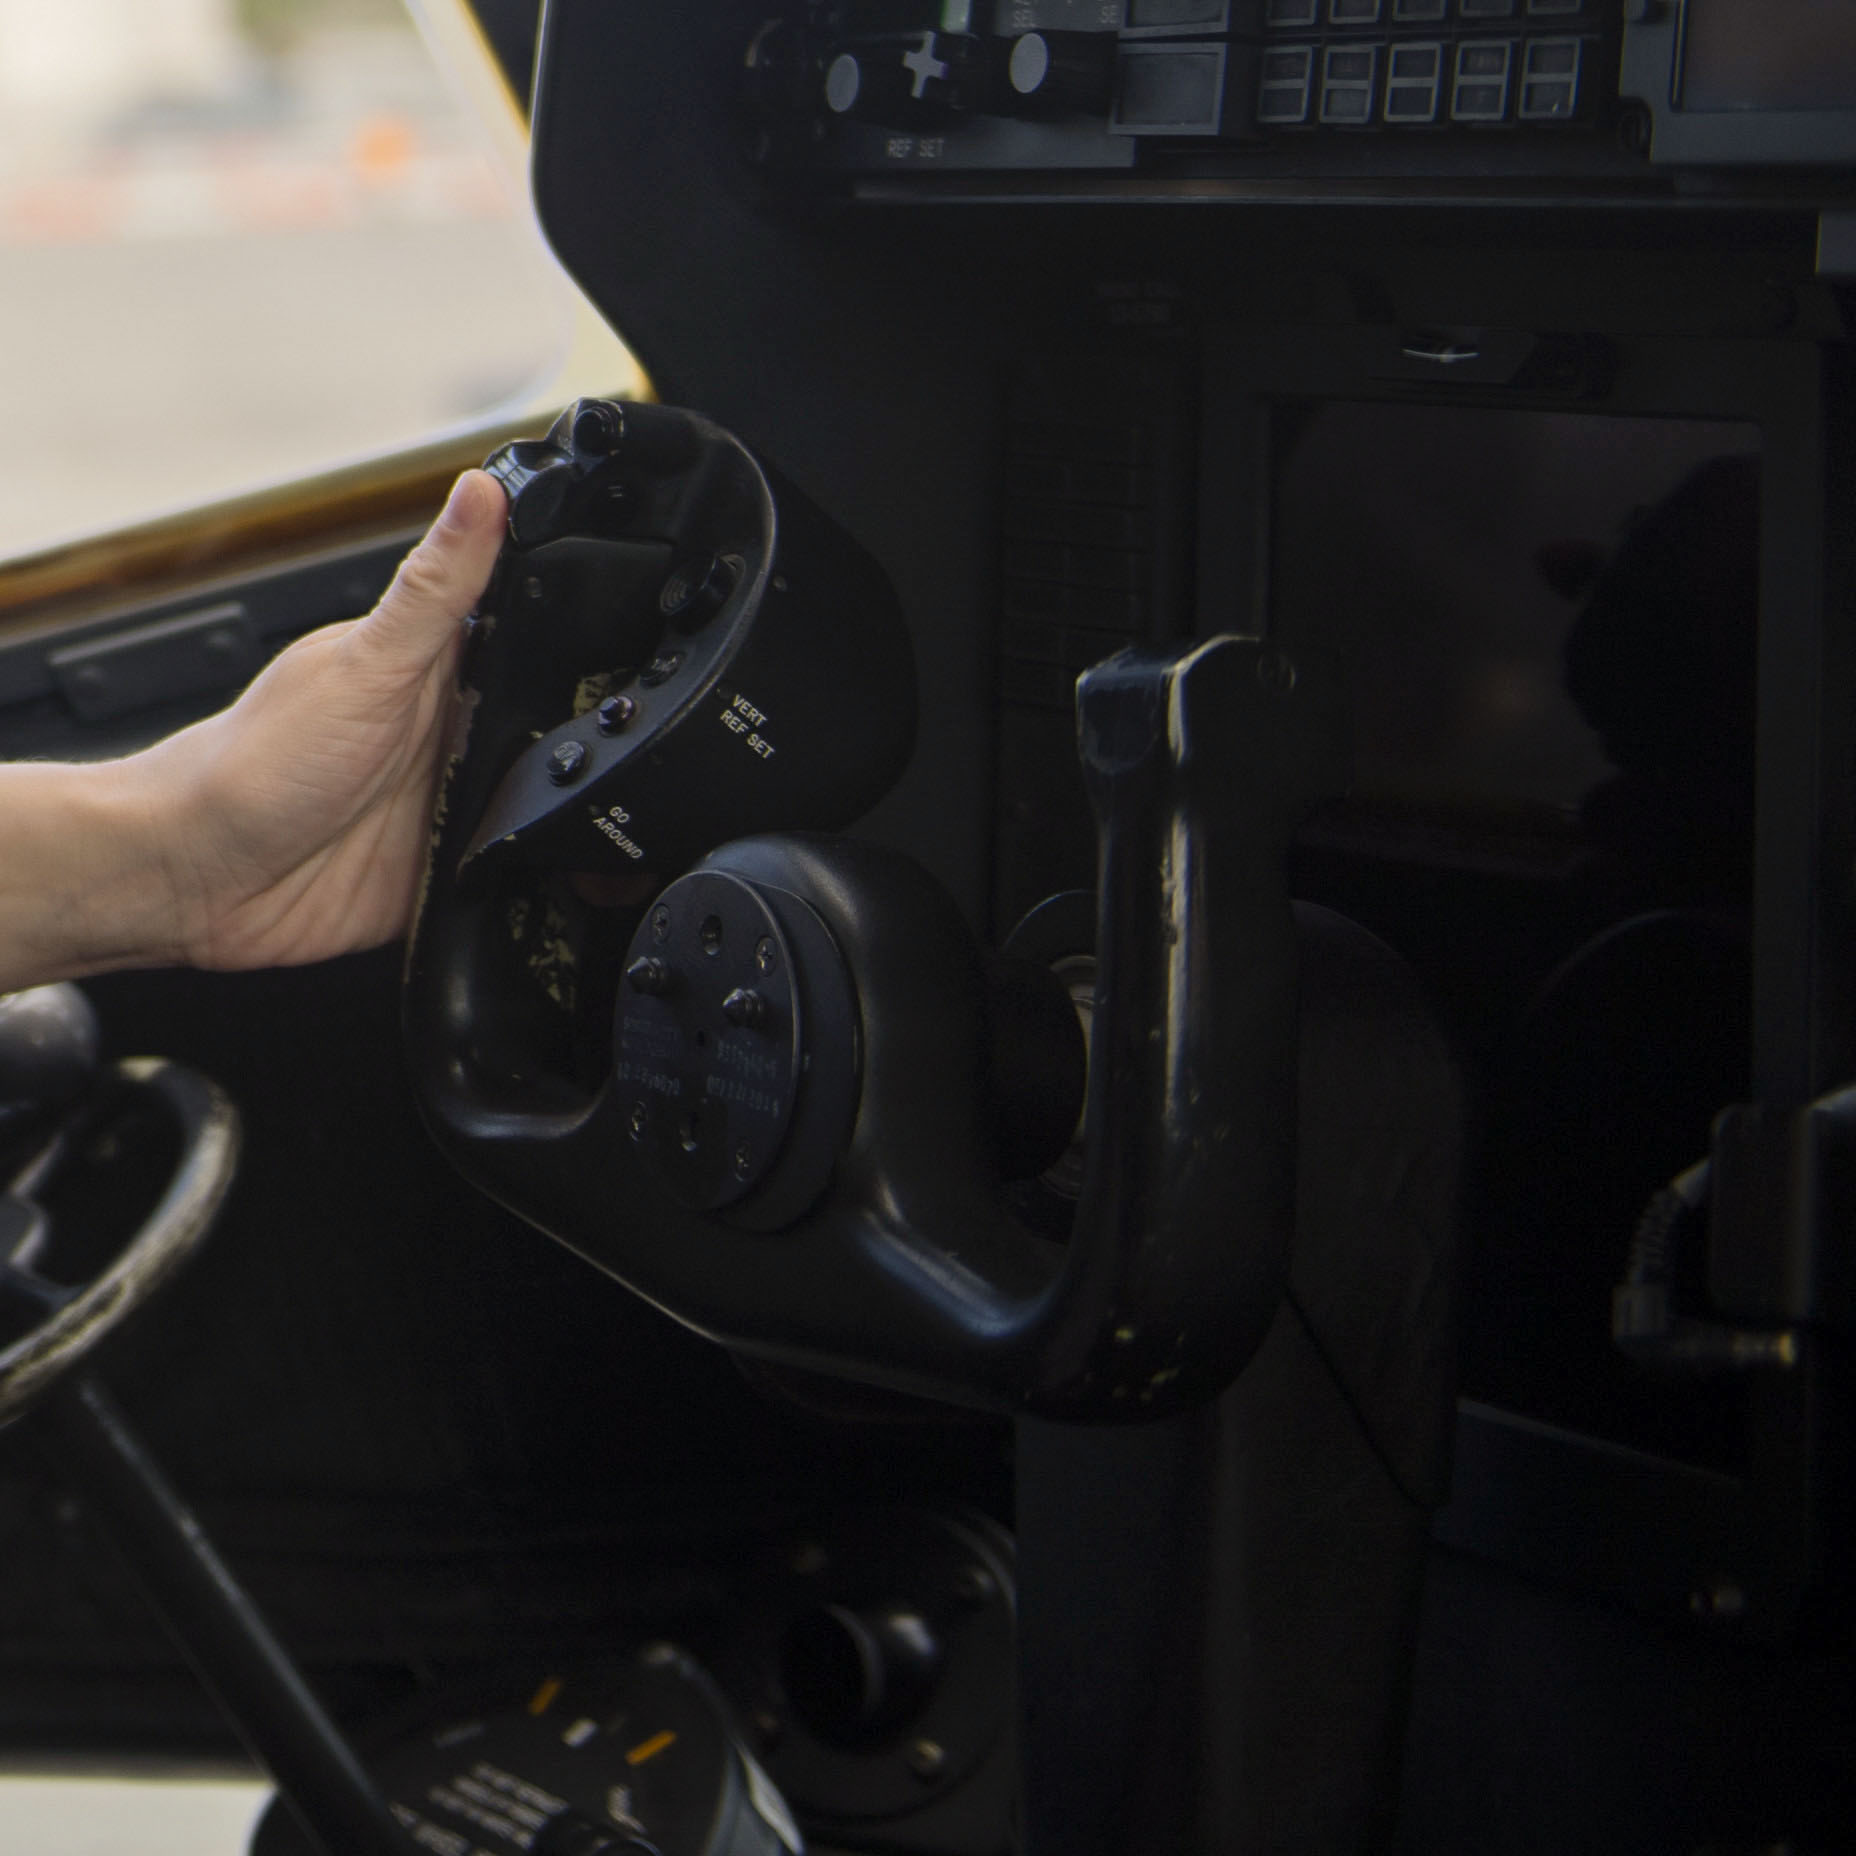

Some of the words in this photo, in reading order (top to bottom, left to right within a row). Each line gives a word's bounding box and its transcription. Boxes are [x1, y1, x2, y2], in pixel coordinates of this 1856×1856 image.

[1012, 8, 1037, 28] SEL
[1100, 5, 1119, 24] SE
[888, 138, 913, 158] REF
[919, 138, 944, 158] SET
[731, 694, 768, 727] VERT
[719, 709, 749, 734] REF
[746, 733, 776, 759] SET
[608, 805, 630, 824] GO
[593, 816, 644, 859] AROUND
